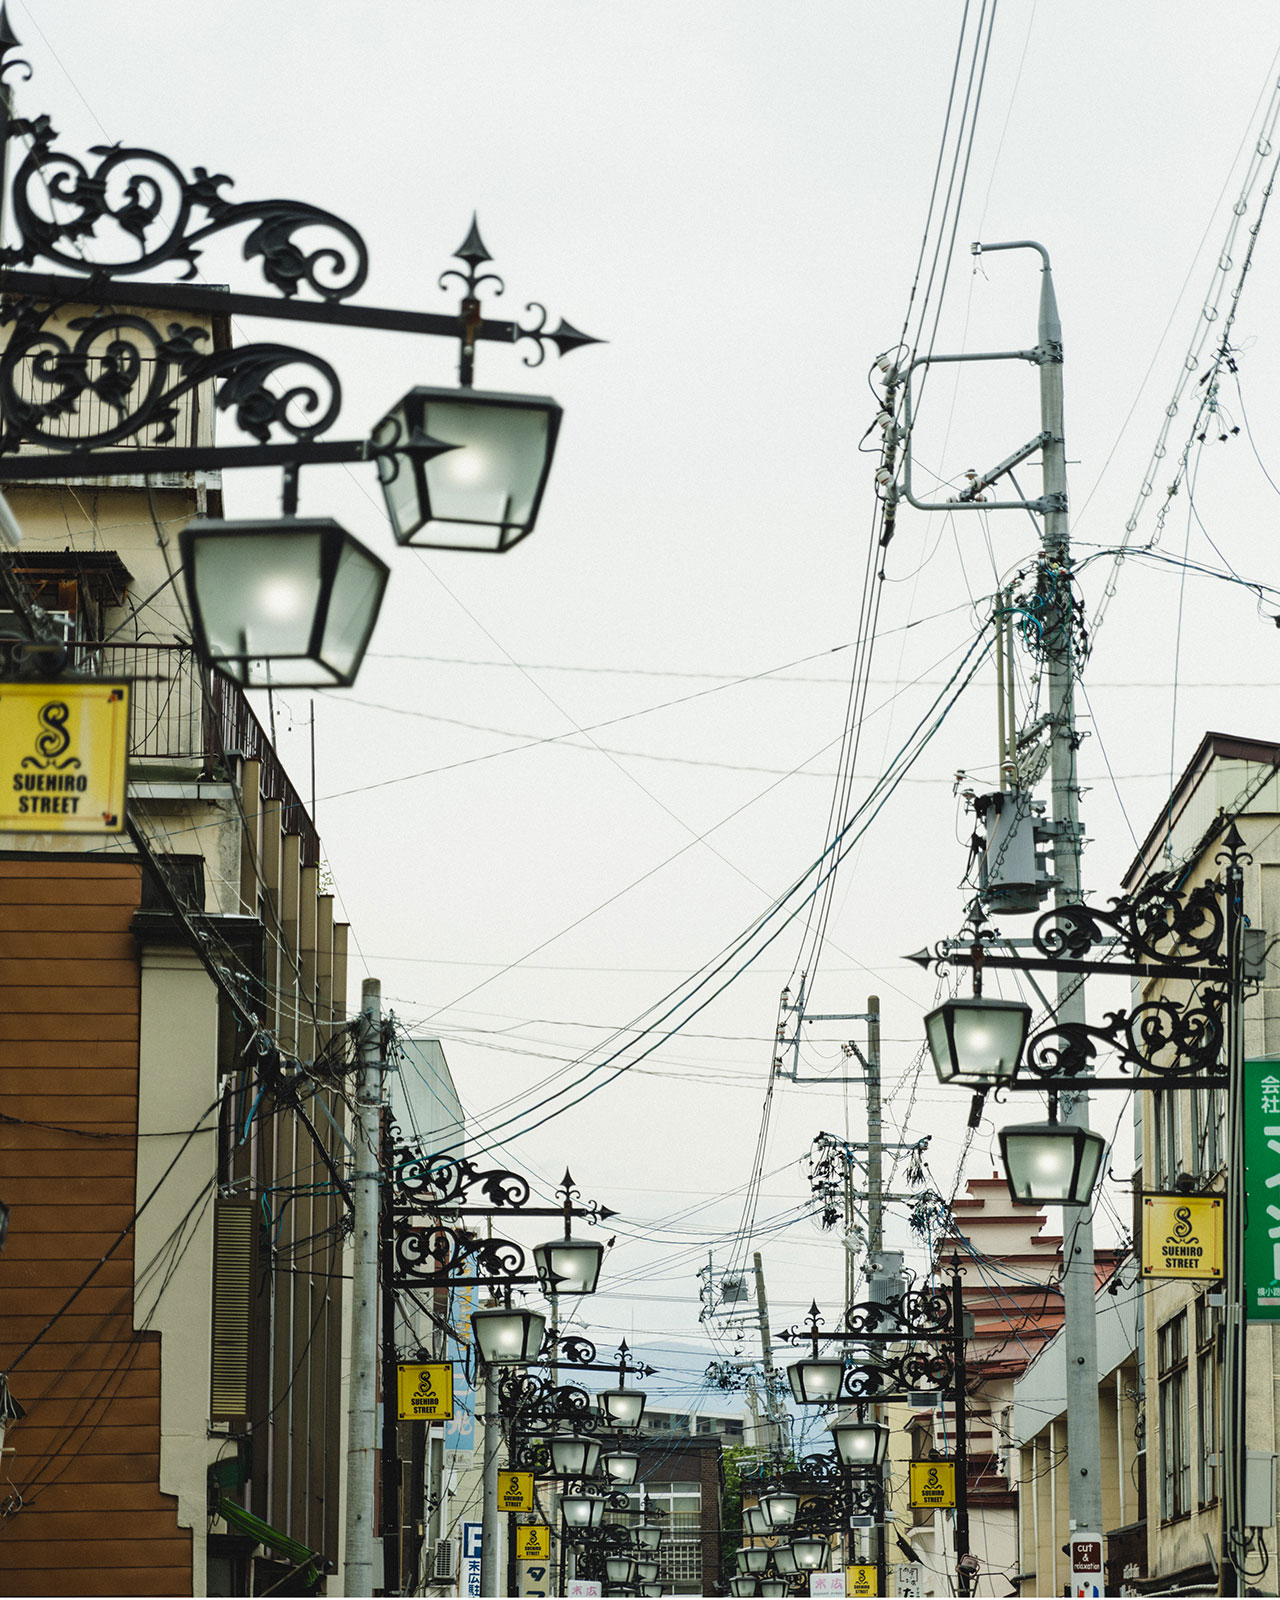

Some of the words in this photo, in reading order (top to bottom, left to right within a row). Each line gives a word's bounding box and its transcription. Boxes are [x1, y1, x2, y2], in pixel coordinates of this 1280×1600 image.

[13, 774, 87, 792] SUEHIRO
[19, 796, 80, 814] STREET
[1261, 1075, 1280, 1114] 会社
[1162, 1246, 1203, 1257] SUEHIRO
[1165, 1258, 1199, 1268] STREET
[411, 1397, 439, 1406] SUEHIRO
[413, 1406, 436, 1414] STREET
[1077, 1543, 1093, 1552] cut
[1082, 1553, 1089, 1562] &
[1074, 1561, 1100, 1570] relaxation
